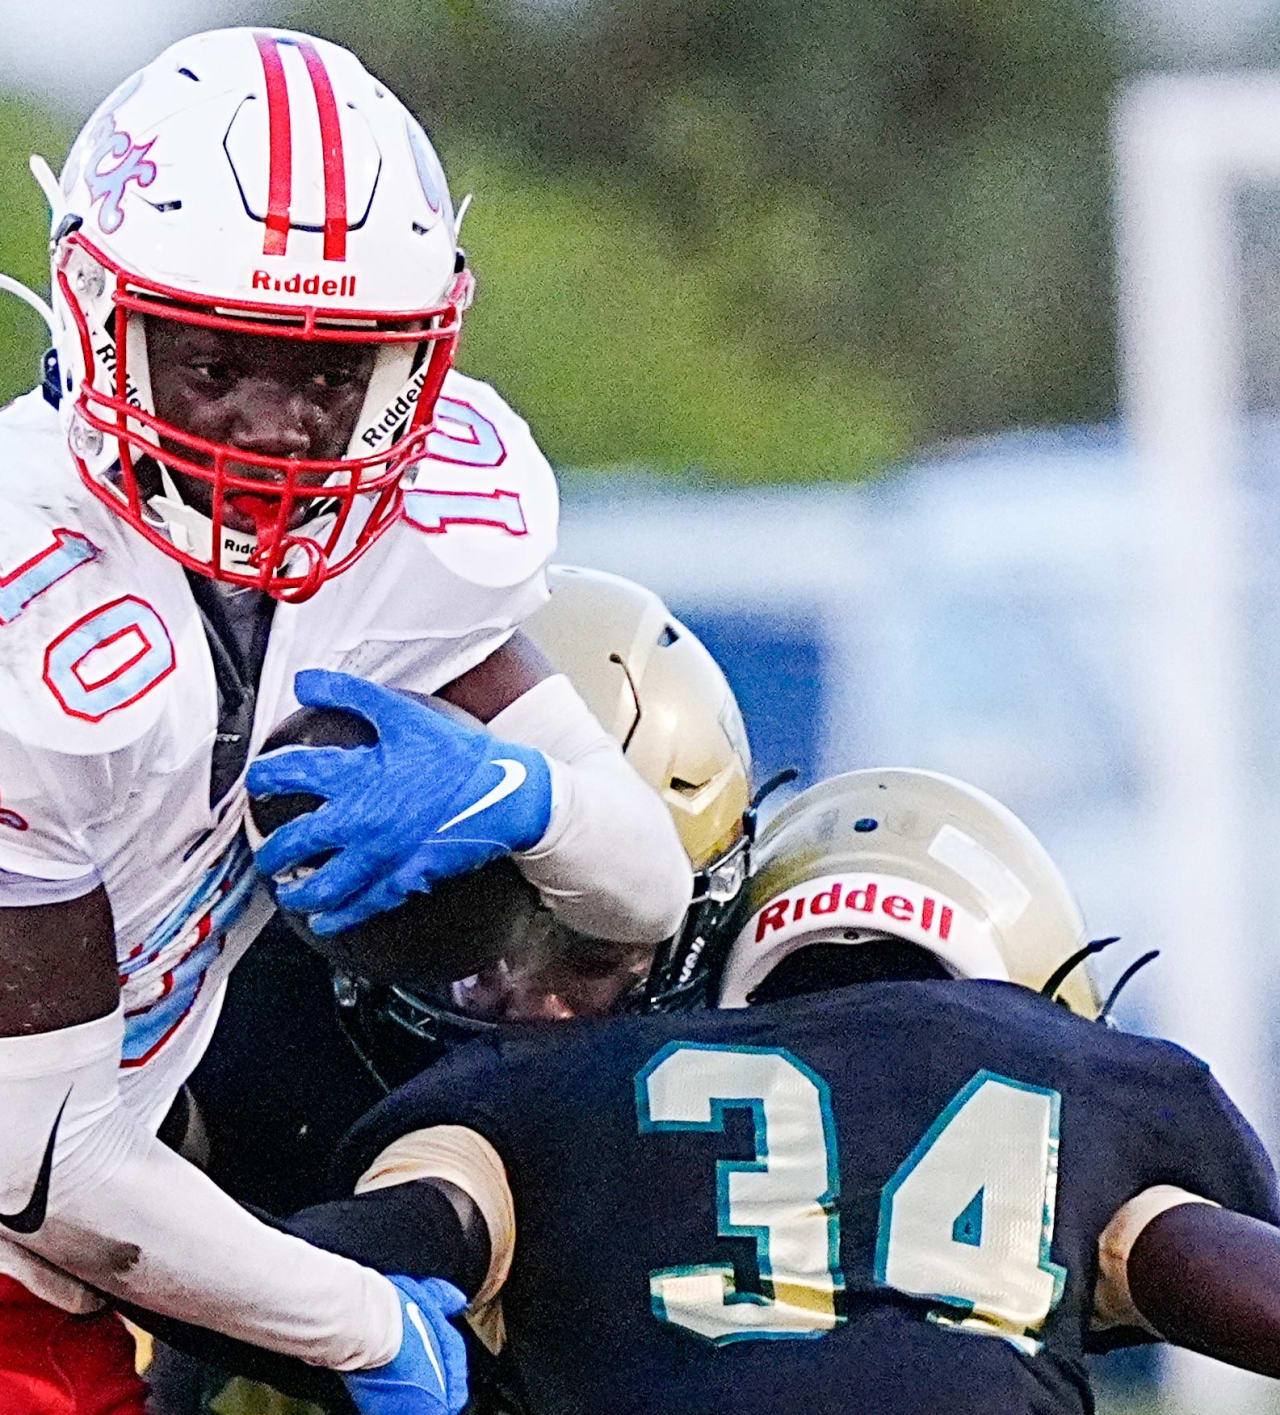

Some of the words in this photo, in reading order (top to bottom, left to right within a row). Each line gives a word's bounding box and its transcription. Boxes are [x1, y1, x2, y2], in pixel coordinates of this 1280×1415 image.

[252, 269, 356, 297] Riddell
[754, 883, 954, 942] Riddell
[635, 1040, 1068, 1357] 34
